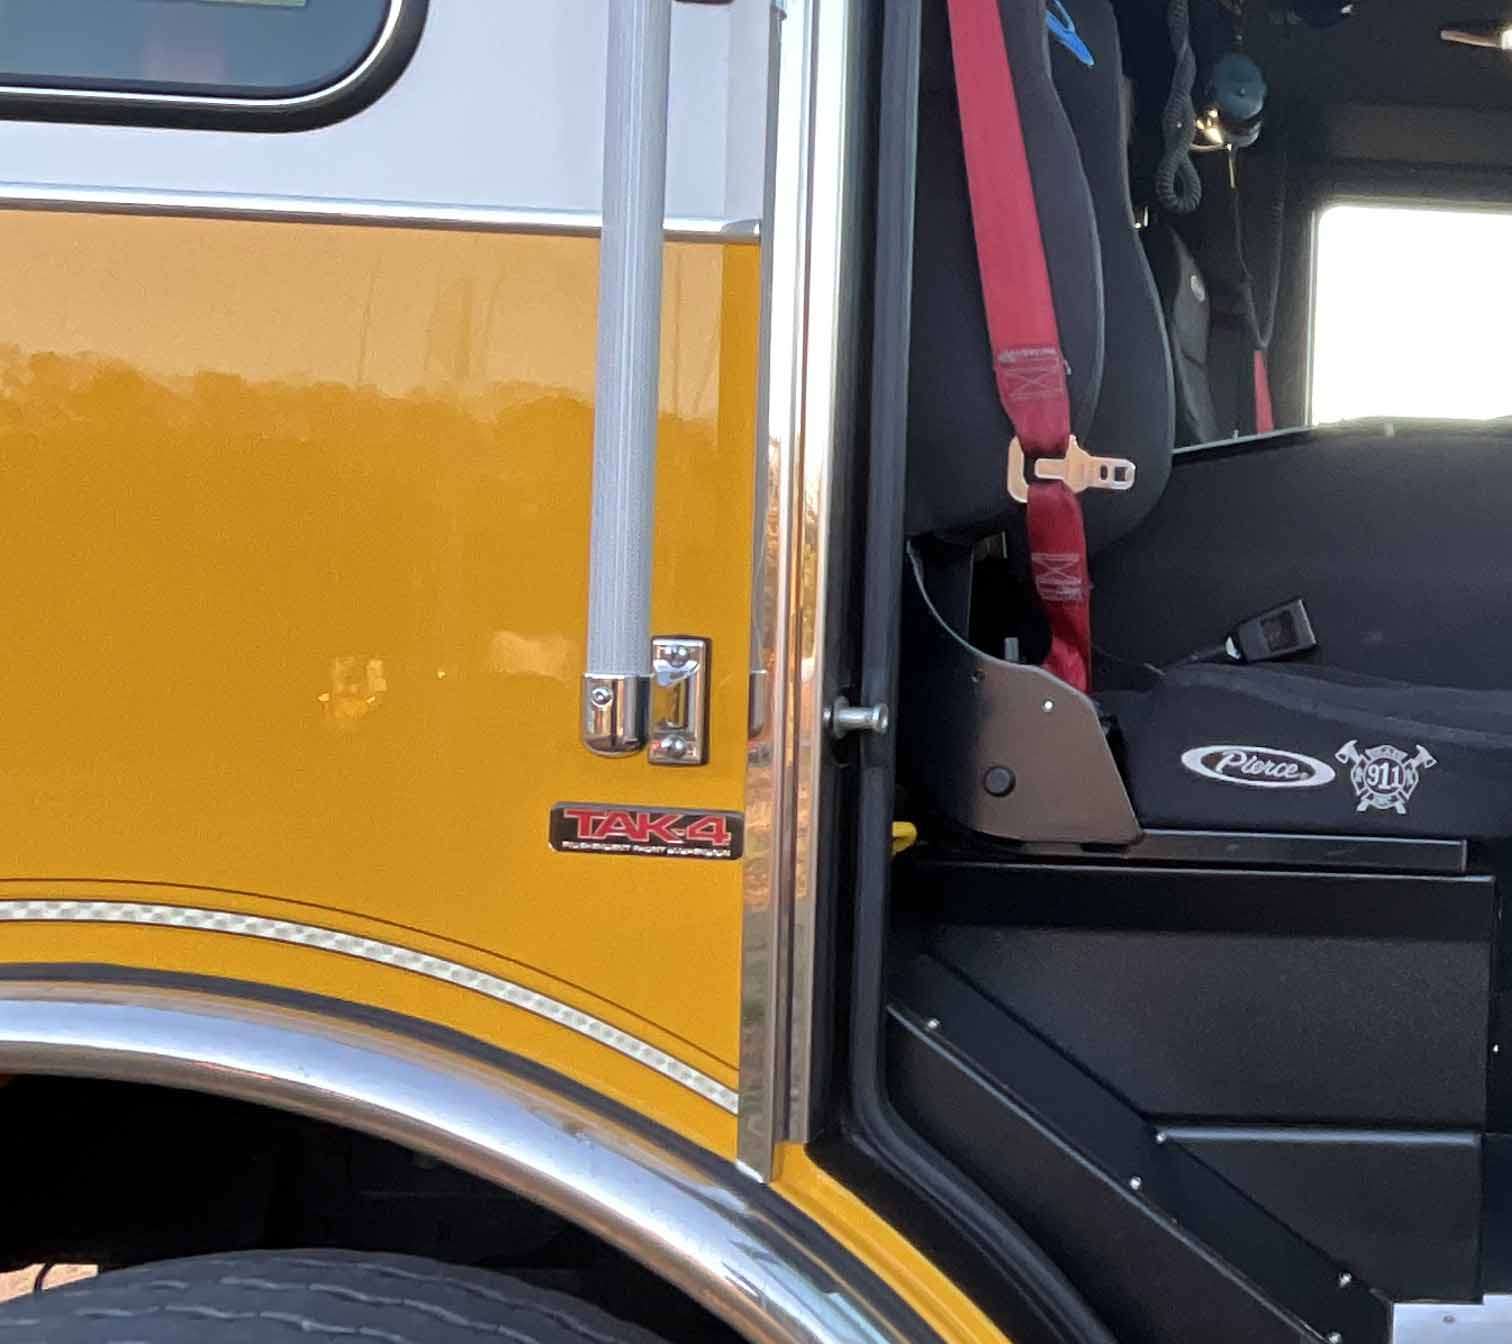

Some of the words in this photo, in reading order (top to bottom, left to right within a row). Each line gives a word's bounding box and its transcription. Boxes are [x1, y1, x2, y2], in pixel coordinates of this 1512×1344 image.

[1215, 749, 1300, 779] Pierce
[1367, 761, 1400, 789] 911
[563, 808, 732, 846] TAK-4
